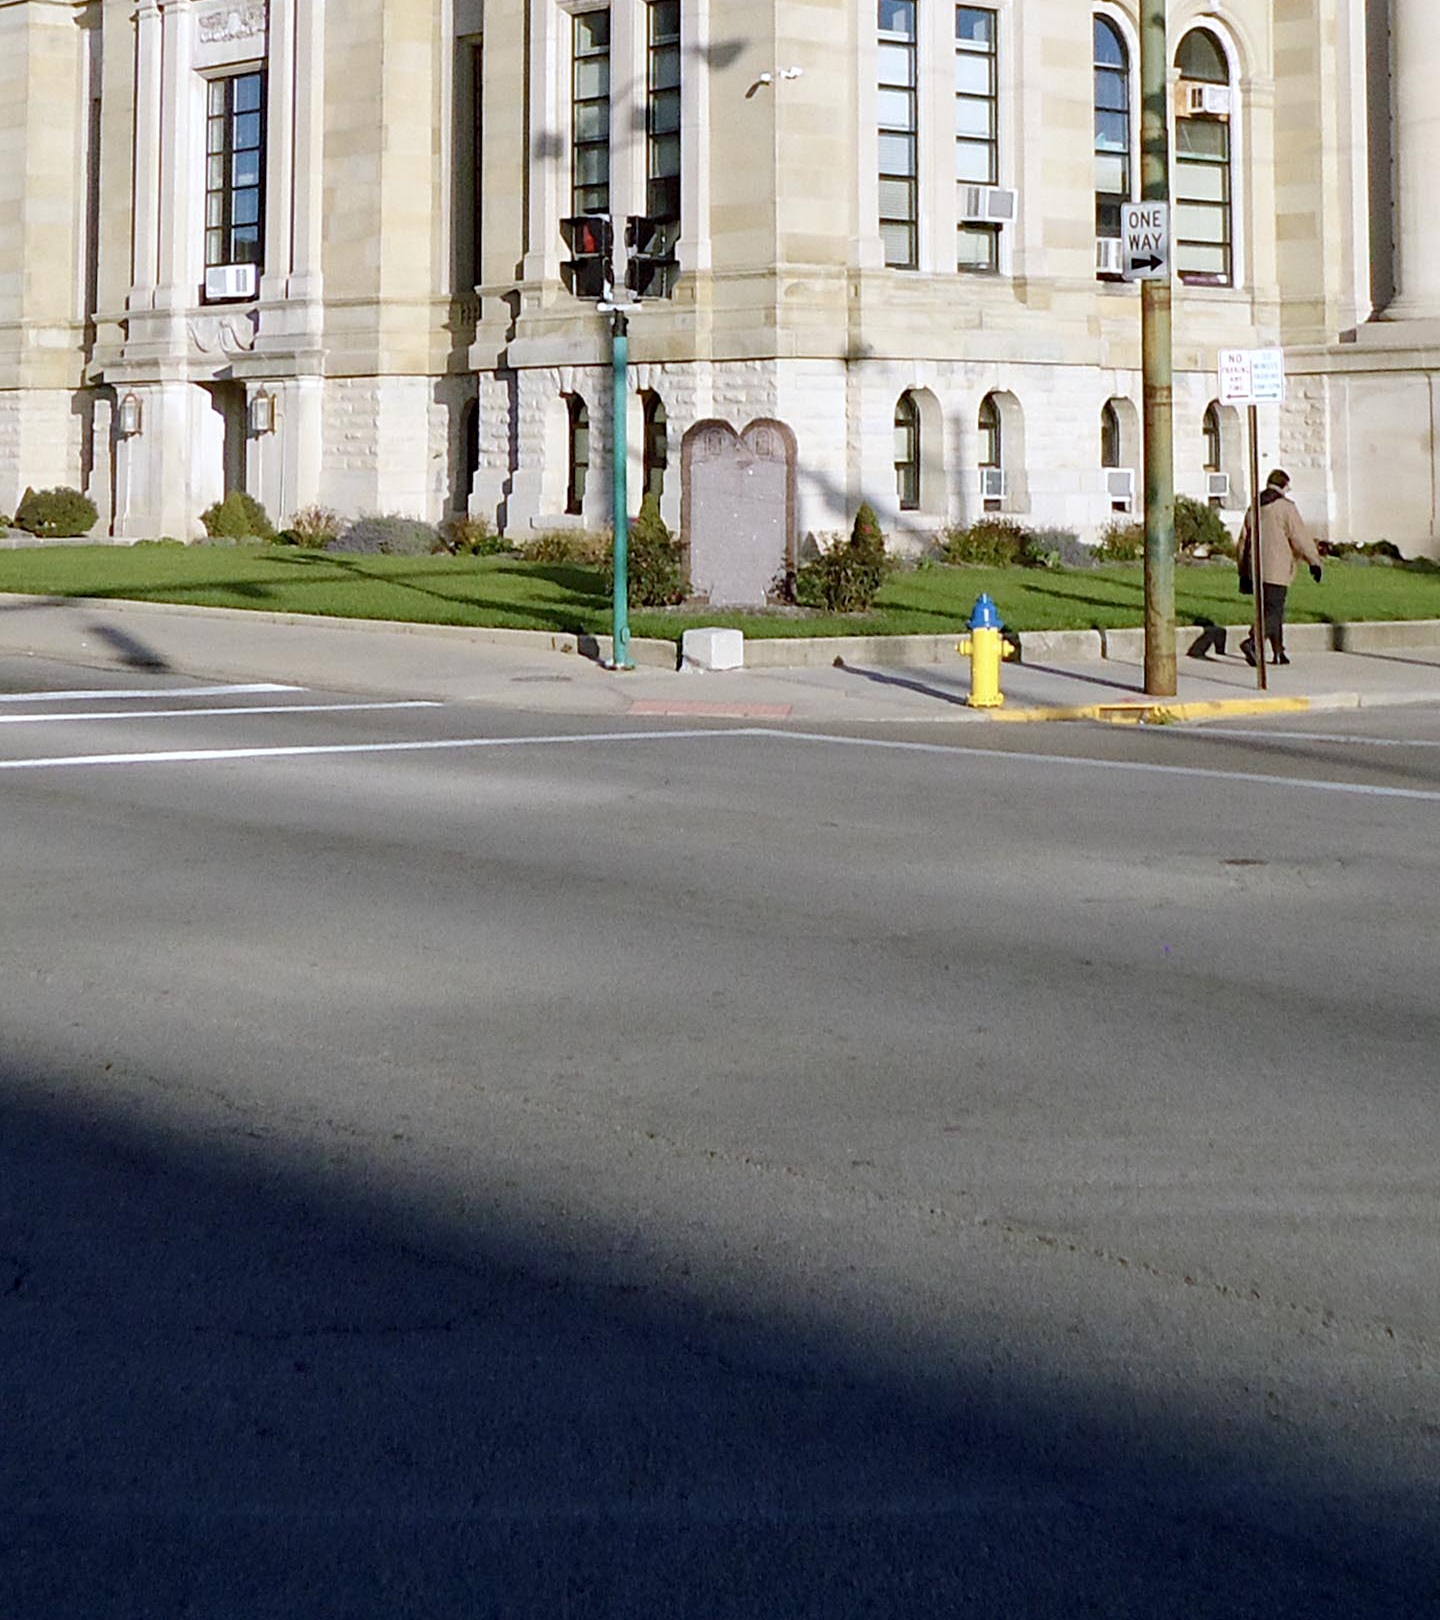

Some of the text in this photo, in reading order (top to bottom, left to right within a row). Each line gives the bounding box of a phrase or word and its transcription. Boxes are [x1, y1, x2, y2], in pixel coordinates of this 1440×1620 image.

[1128, 210, 1161, 229] ONE
[1128, 233, 1162, 251] WAY
[1228, 354, 1242, 364] NO
